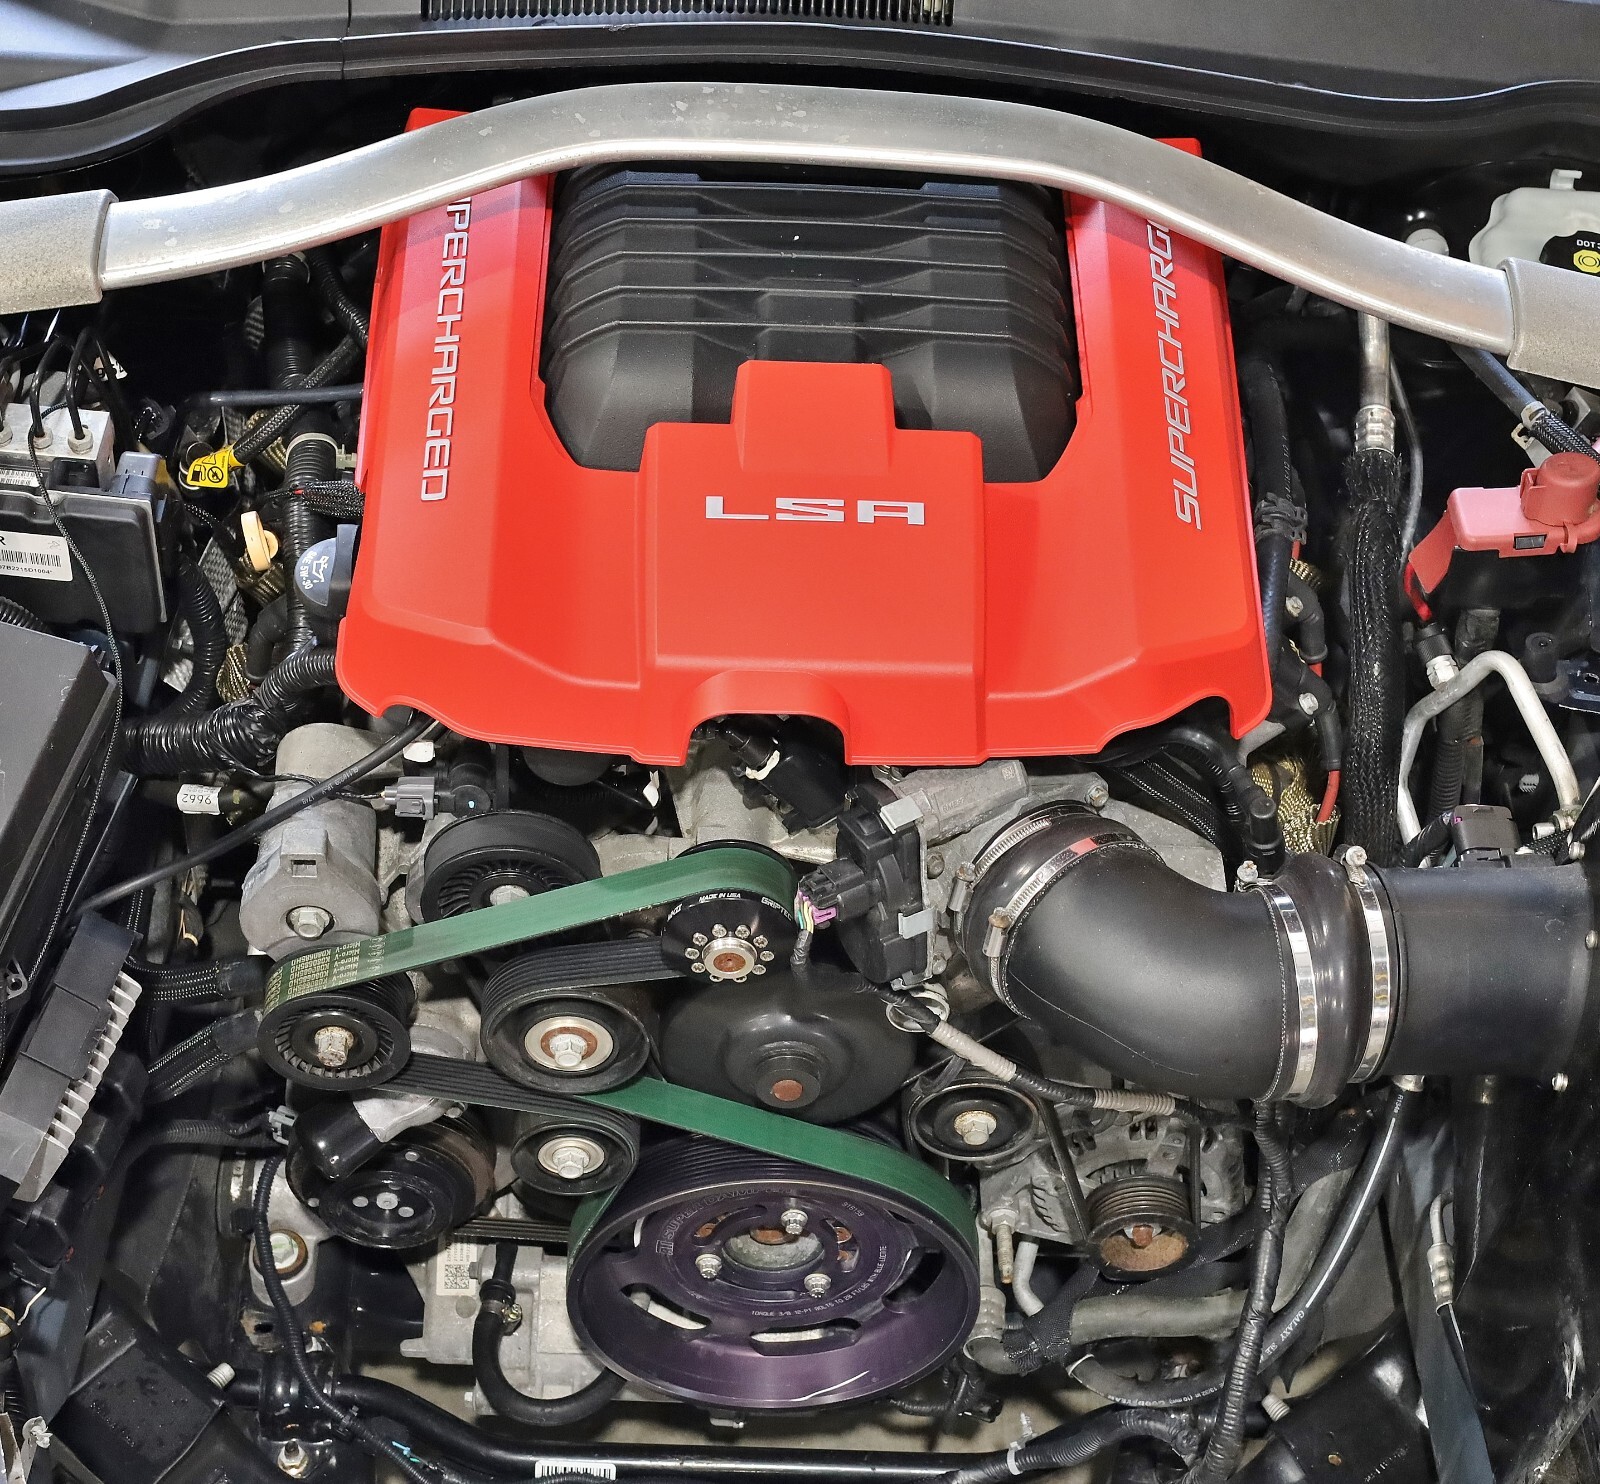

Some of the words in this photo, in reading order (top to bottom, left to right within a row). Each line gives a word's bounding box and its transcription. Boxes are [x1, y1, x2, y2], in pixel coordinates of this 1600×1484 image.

[1576, 239, 1596, 248] DOT
[420, 196, 472, 501] PERCHARGED
[1146, 218, 1202, 531] SUPERCHARG
[705, 495, 925, 526] LSA
[302, 550, 317, 565] SAE
[300, 565, 314, 590] 5W-30
[698, 893, 718, 903] MADE
[1279, 1309, 1306, 1342] GALAXY
[1107, 1394, 1166, 1407] GOODYEAR
